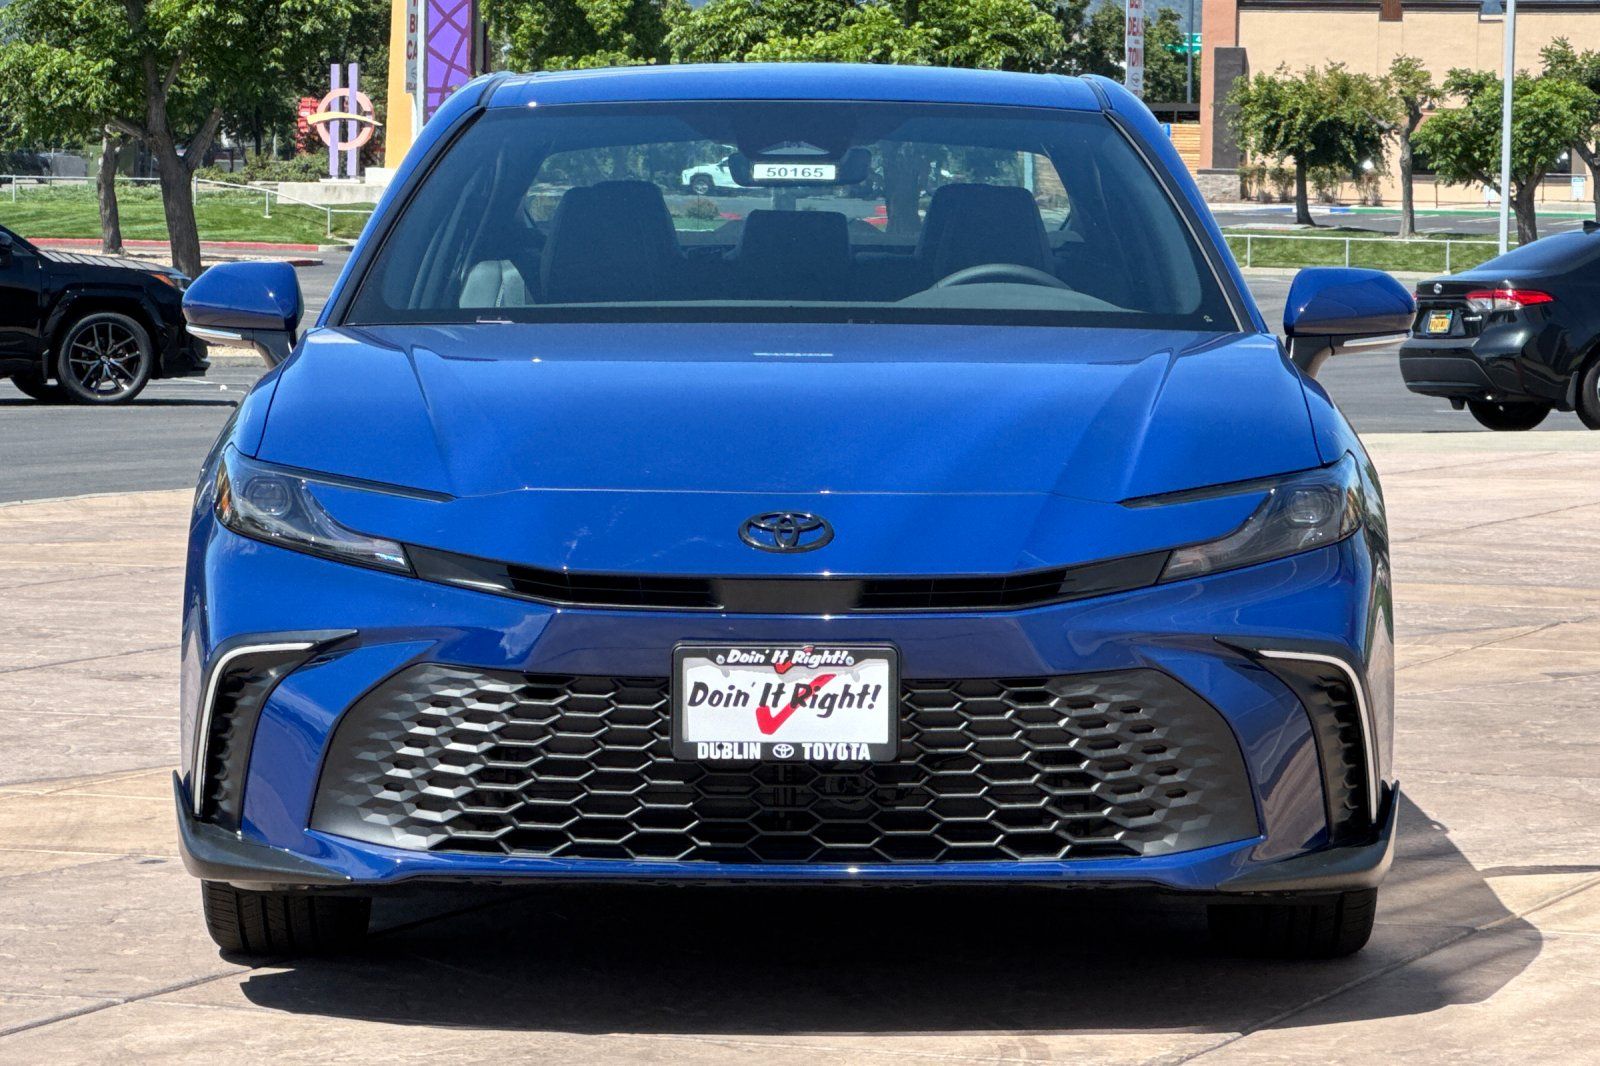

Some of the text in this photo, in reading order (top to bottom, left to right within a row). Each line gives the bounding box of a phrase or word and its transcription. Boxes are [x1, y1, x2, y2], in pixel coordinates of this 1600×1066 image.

[766, 167, 824, 178] 50165
[726, 649, 846, 668] Doin' It Right!
[687, 680, 882, 718] Doin' It Right!
[697, 742, 871, 761] DUBLIN TOYOTA
